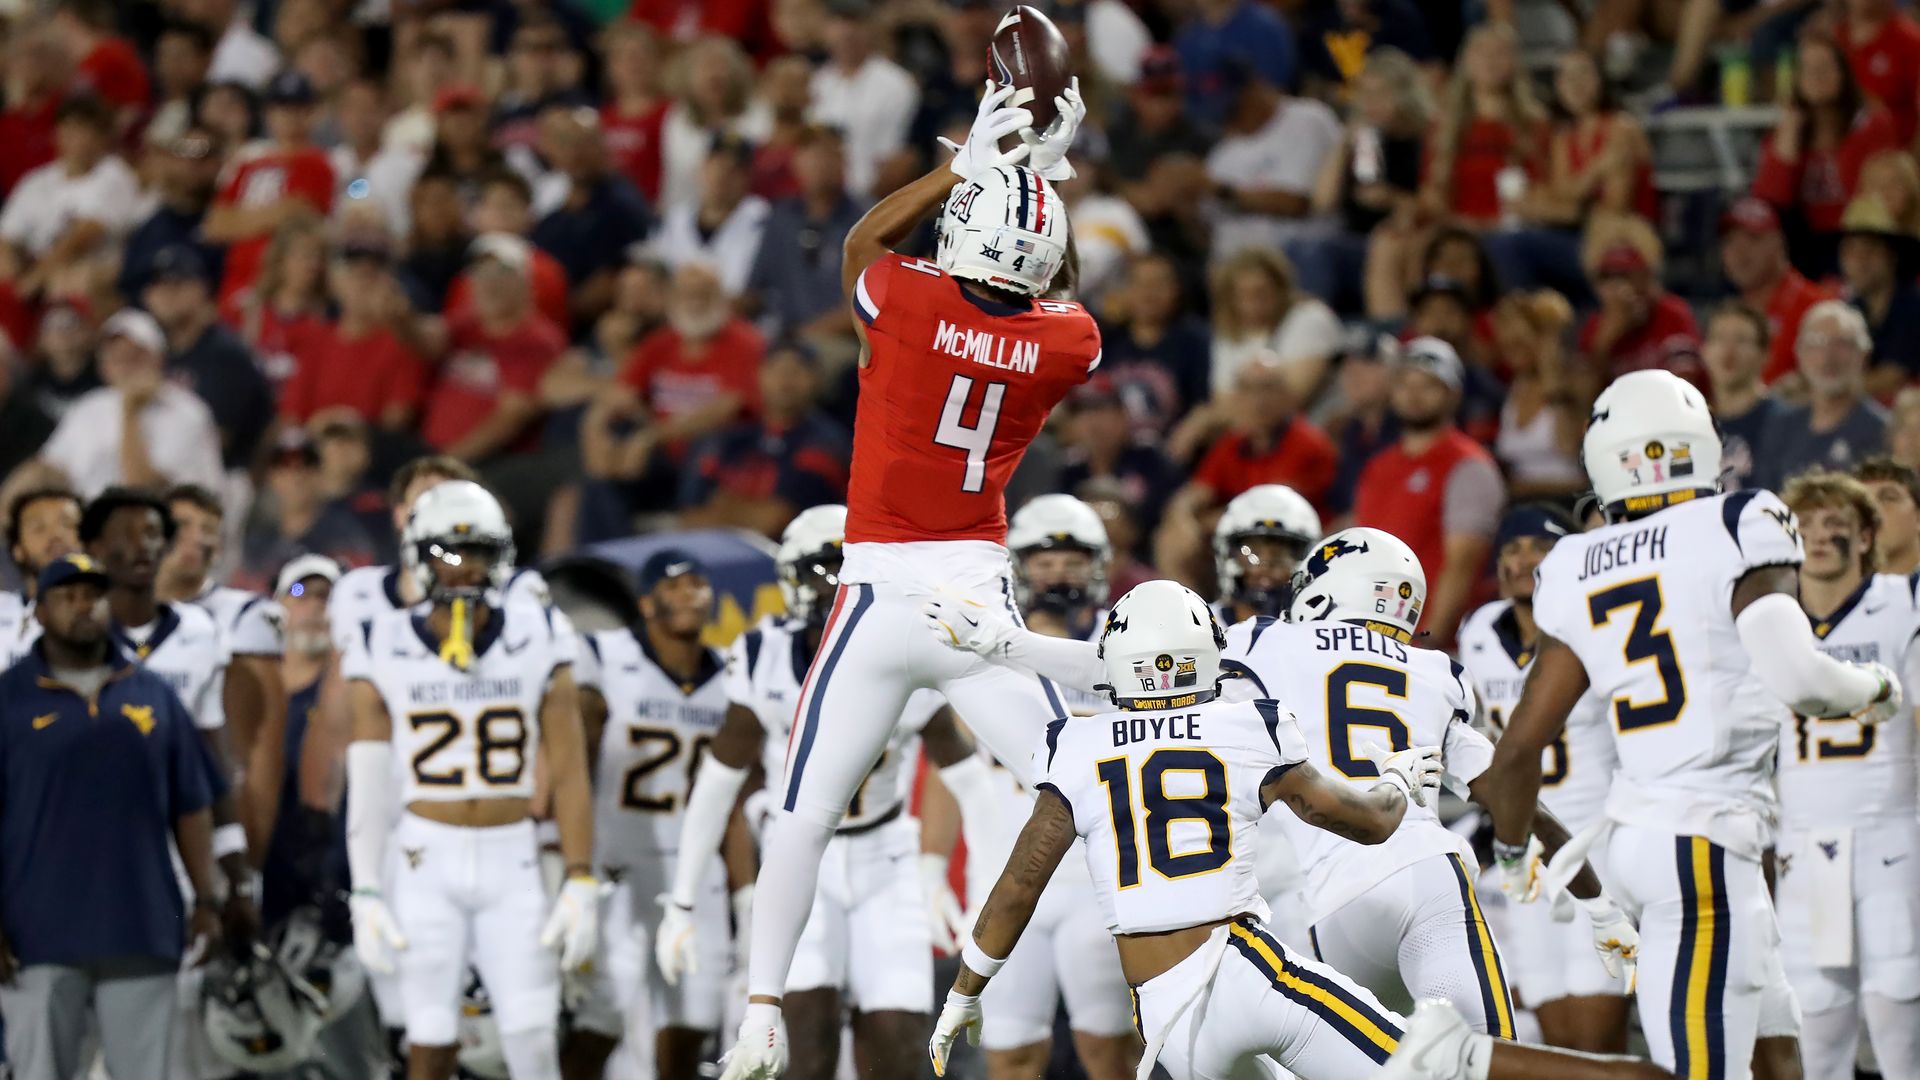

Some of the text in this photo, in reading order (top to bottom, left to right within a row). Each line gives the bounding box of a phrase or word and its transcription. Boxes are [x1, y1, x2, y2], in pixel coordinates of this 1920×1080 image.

[1012, 255, 1025, 272] 4
[932, 319, 1040, 374] McMILLAN
[933, 372, 1007, 493] 4
[1578, 525, 1668, 581] JOSEPH
[1375, 598, 1387, 613] 6
[1157, 660, 1172, 669] 44
[1315, 626, 1408, 664] SPELLS
[1586, 571, 1688, 735] 3
[1133, 694, 1196, 709] COUNTRY ROADS
[1140, 677, 1156, 692] 18
[1112, 713, 1202, 747] BOYCE
[1324, 660, 1412, 780] 6
[406, 705, 528, 788] 28
[1095, 747, 1235, 891] 18
